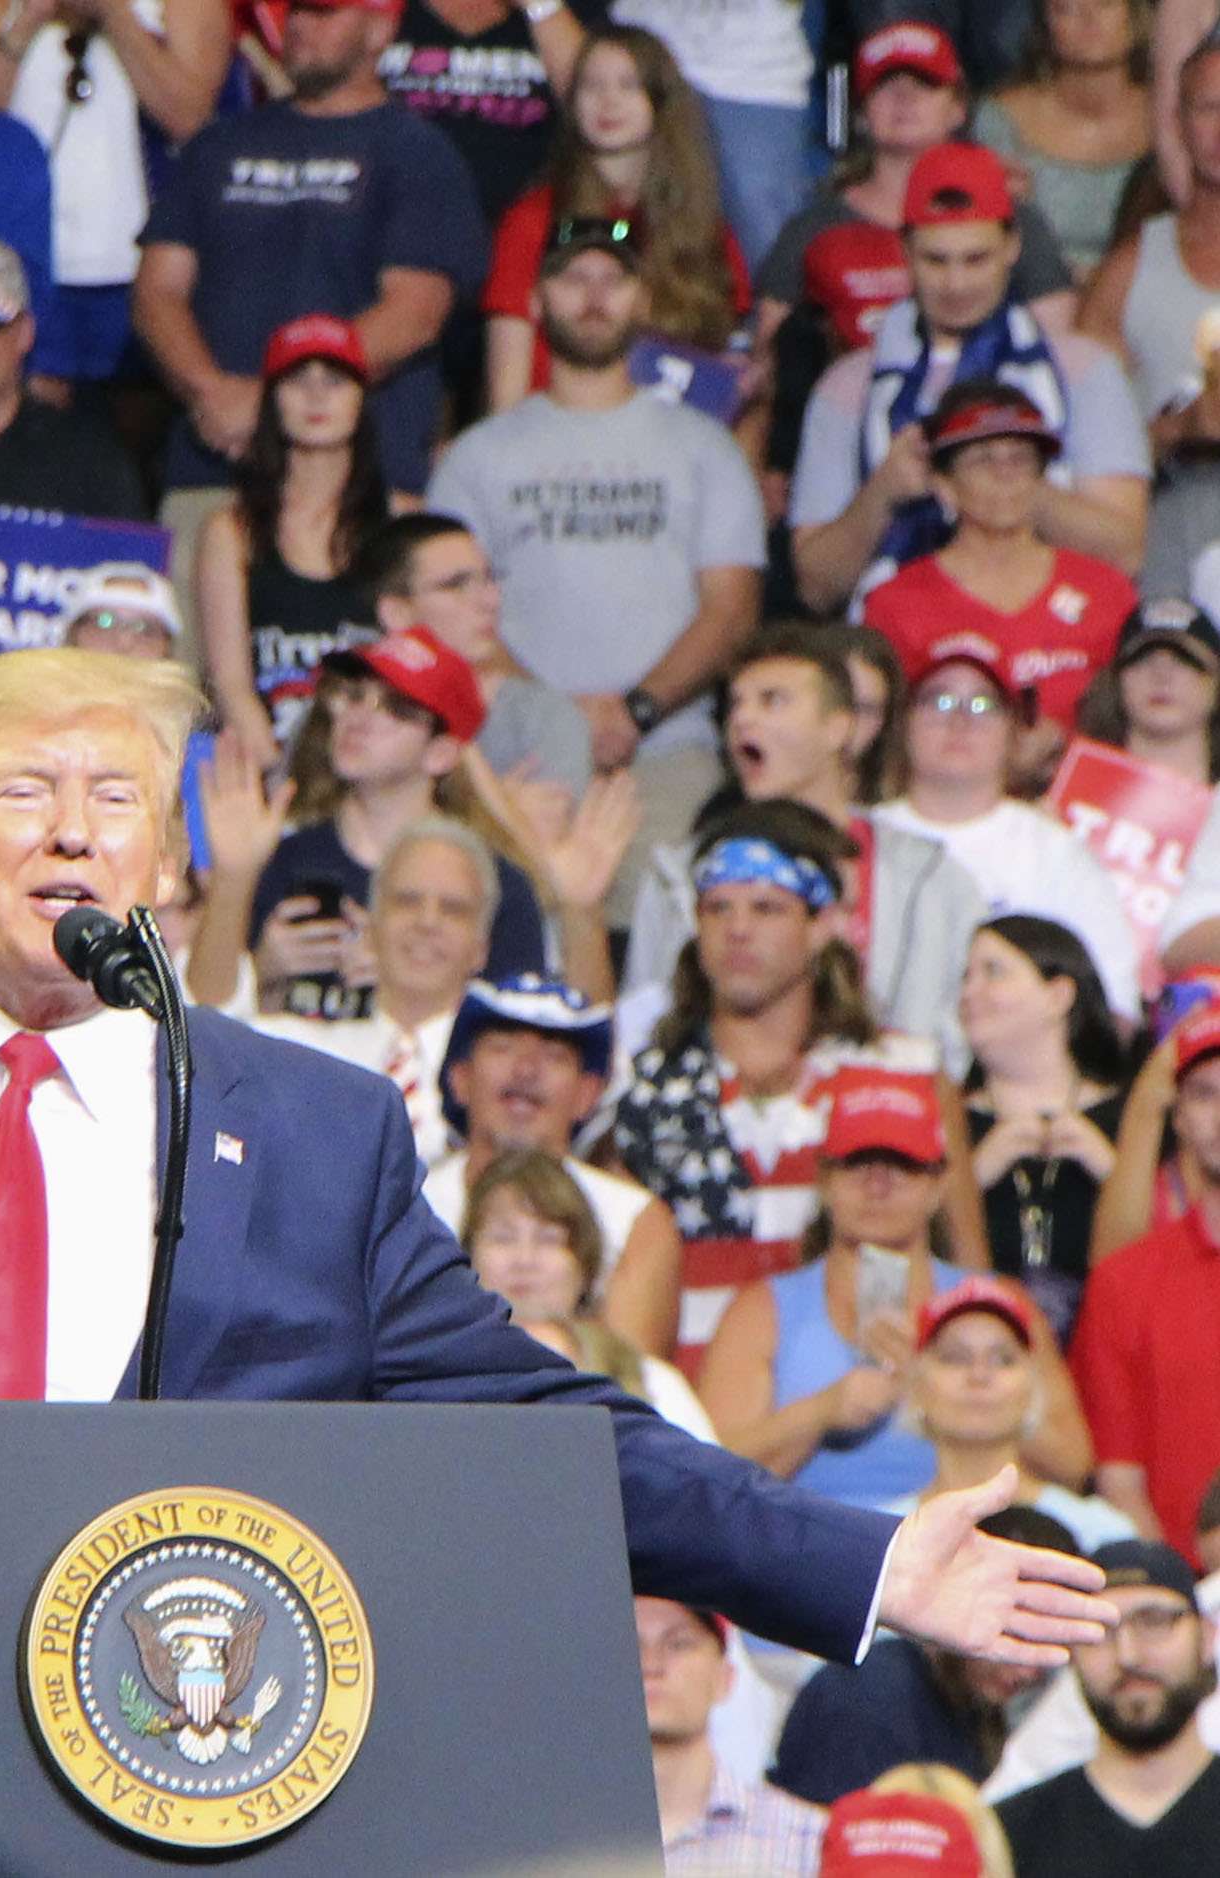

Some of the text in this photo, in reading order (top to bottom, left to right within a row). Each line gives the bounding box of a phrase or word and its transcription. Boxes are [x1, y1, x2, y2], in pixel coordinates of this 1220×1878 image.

[39, 1502, 361, 1829] SEAL OF THE PRESIDENT OF THE UNITED STATES
